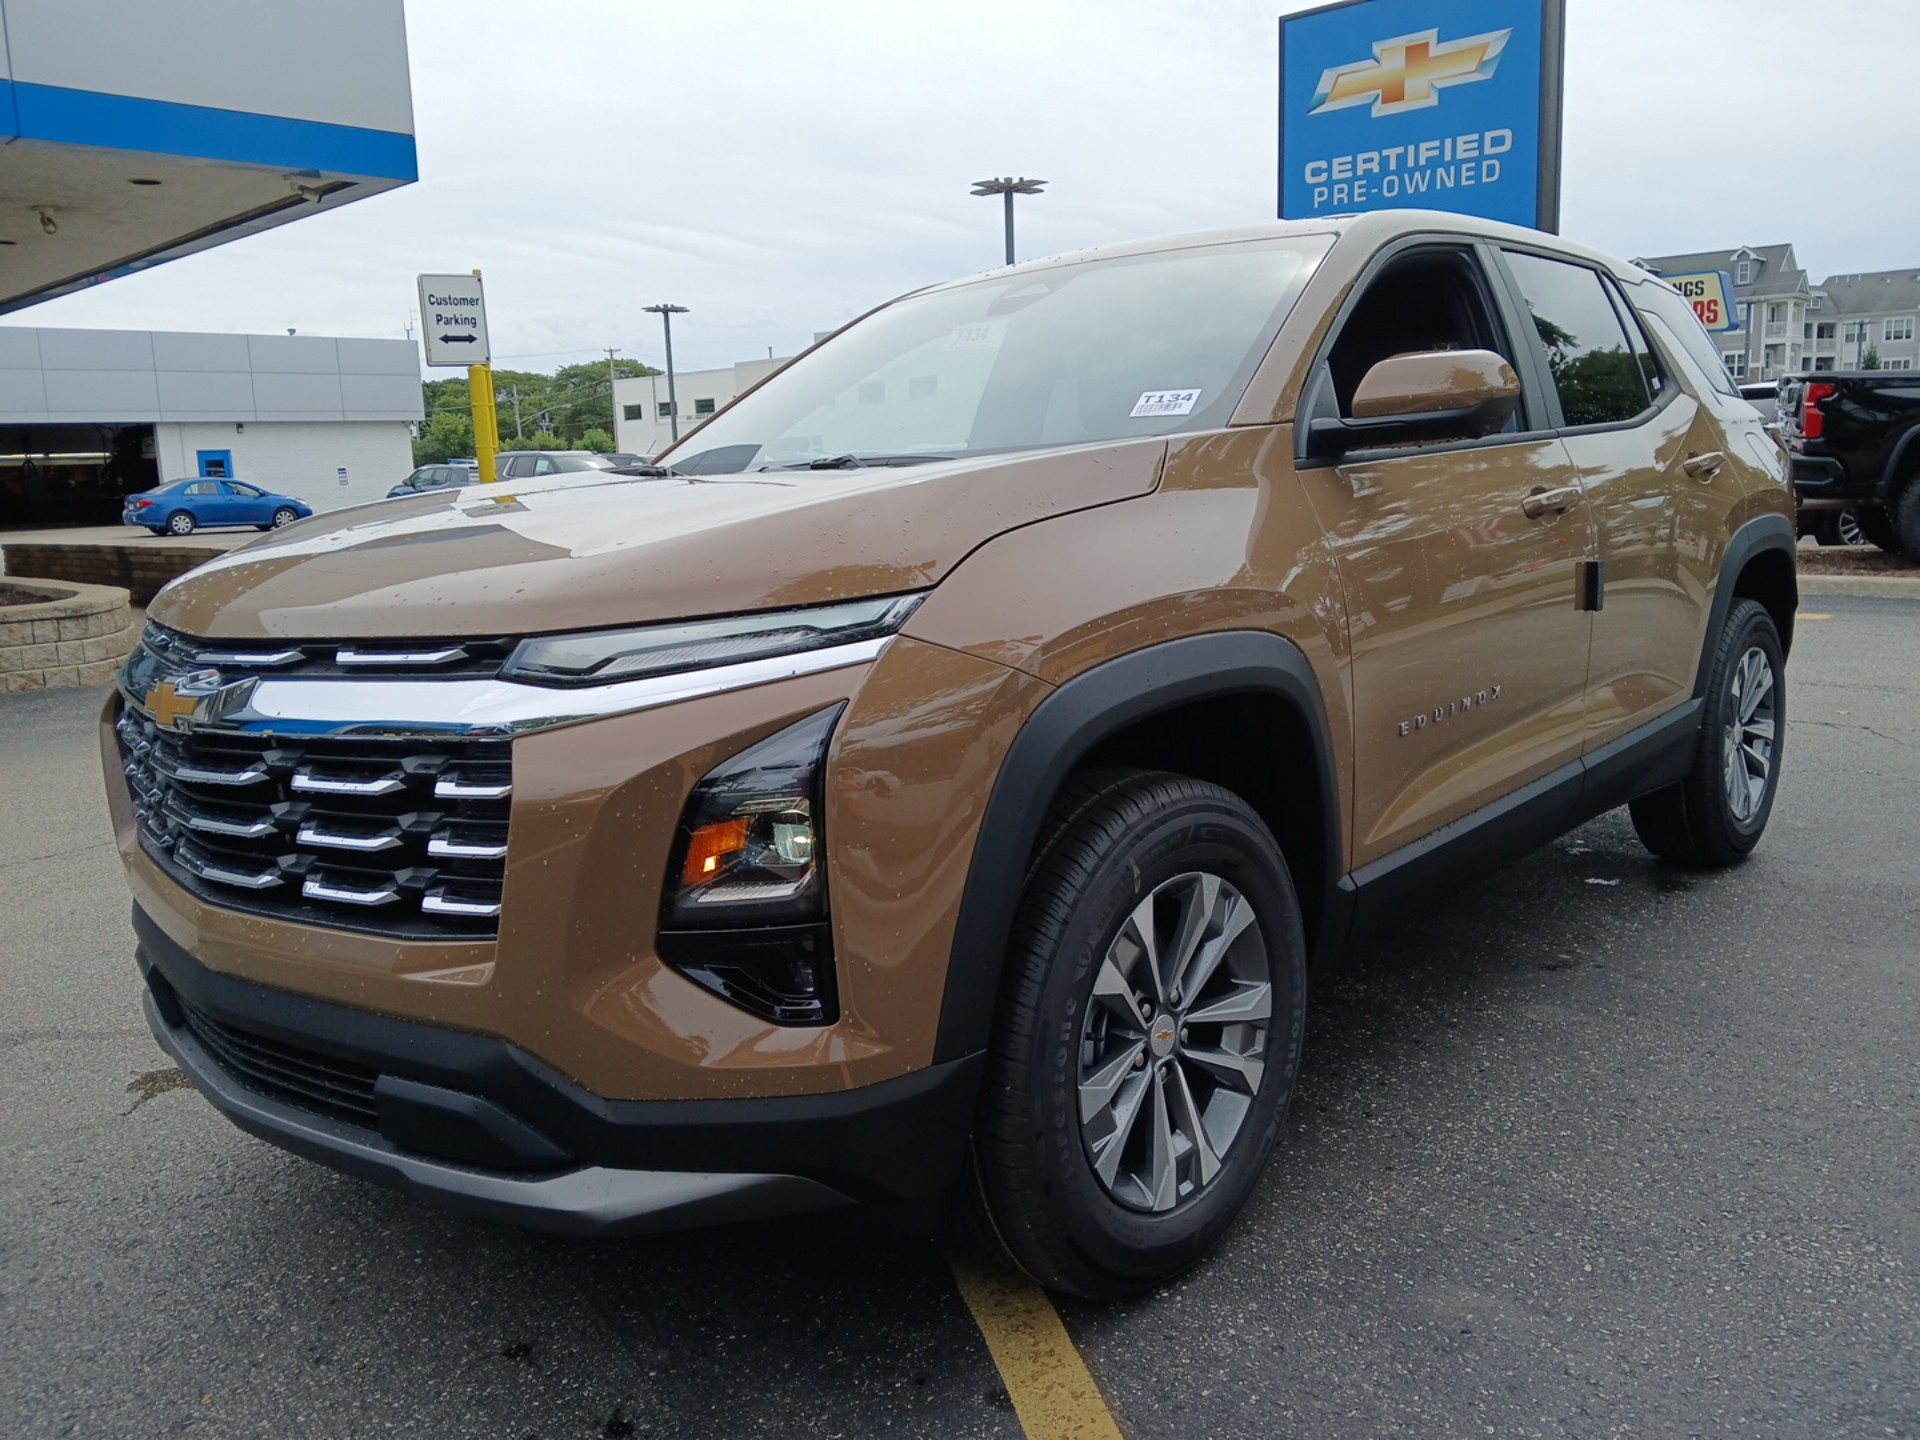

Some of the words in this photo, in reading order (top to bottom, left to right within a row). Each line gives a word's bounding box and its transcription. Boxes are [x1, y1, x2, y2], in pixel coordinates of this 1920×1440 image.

[1304, 128, 1513, 185] CERTIFIED
[1313, 159, 1501, 209] PRE-OWNED
[428, 293, 480, 307] Customer
[435, 313, 478, 329] Parking
[1143, 392, 1194, 404] T134
[1398, 684, 1501, 737] EQUINOX
